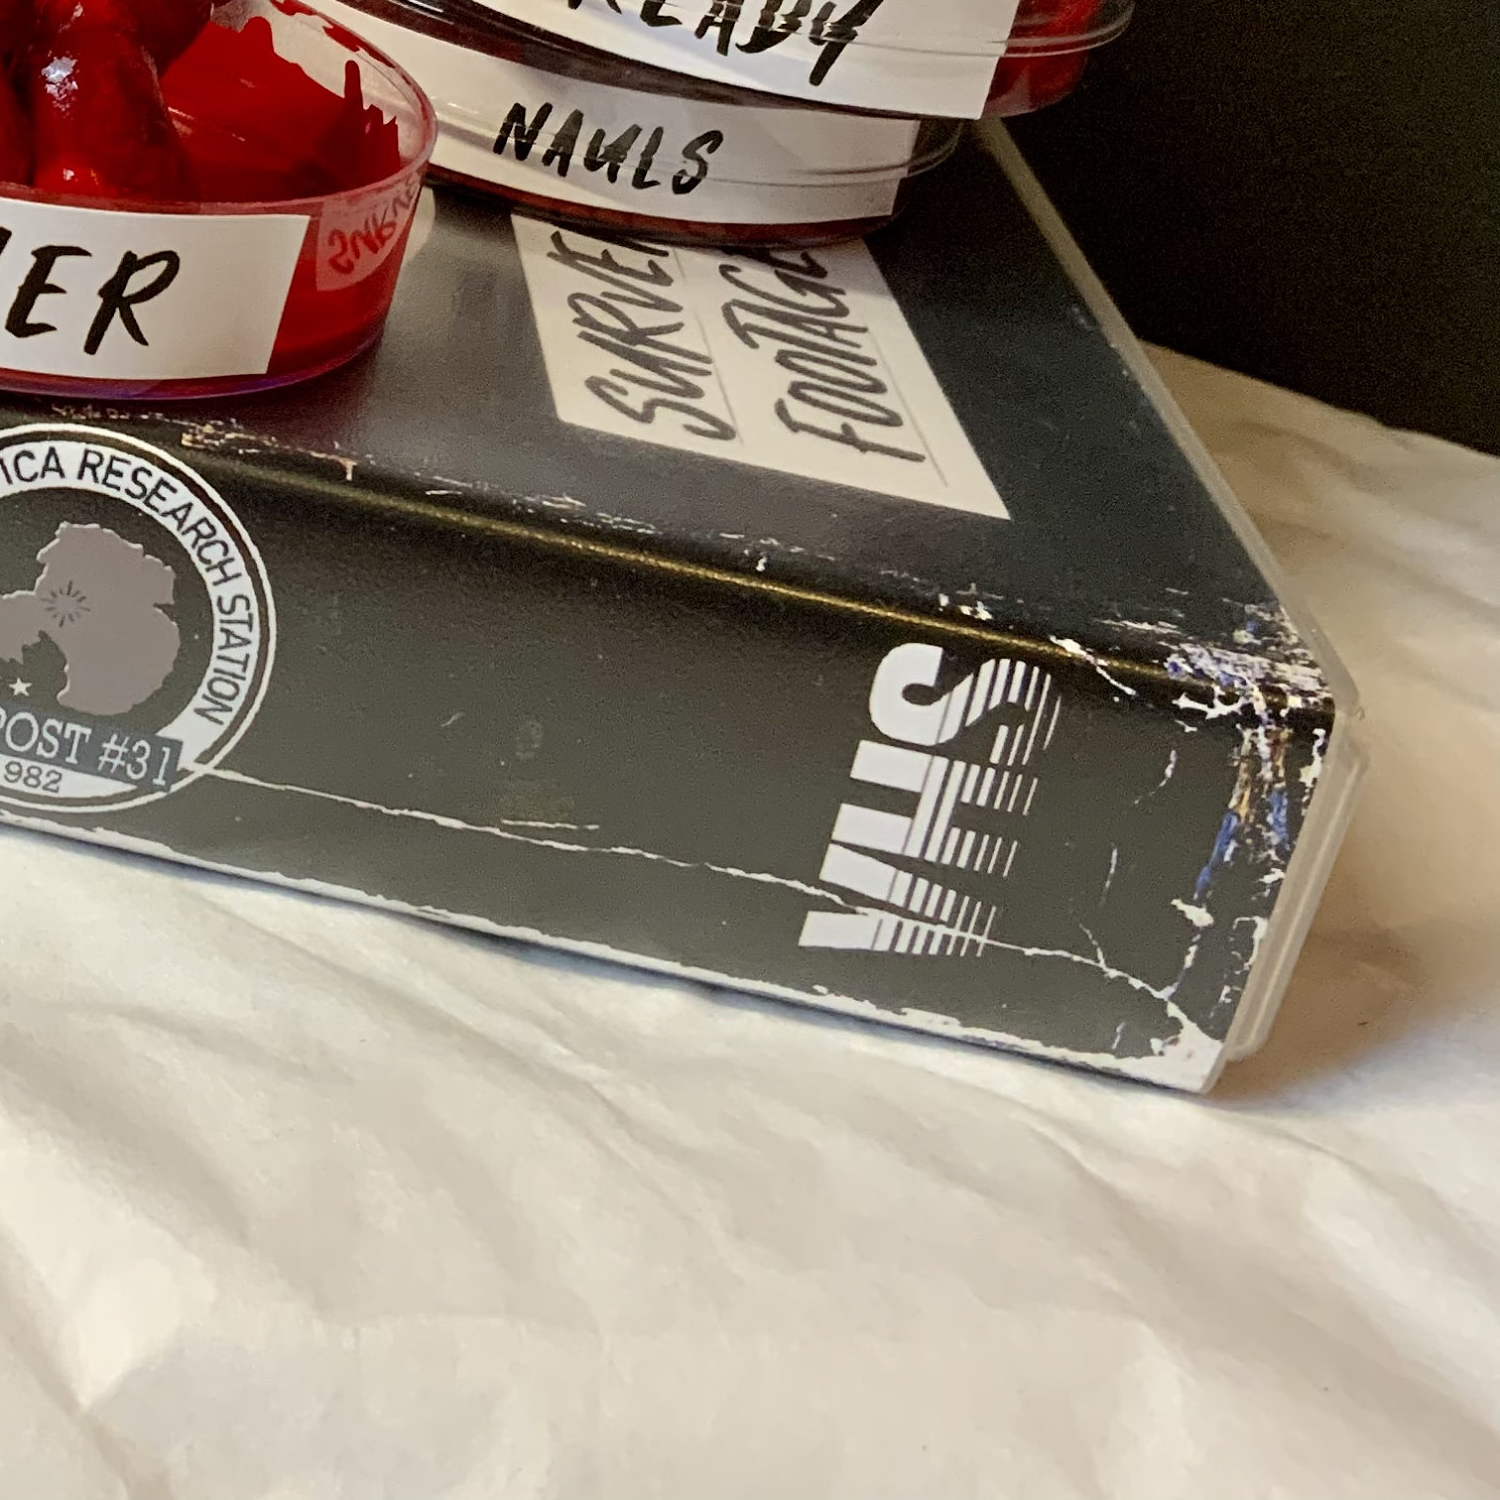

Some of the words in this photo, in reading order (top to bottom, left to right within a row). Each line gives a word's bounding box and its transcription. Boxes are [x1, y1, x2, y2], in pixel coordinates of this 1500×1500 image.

[491, 100, 725, 196] NAULS
[76, 448, 243, 588] RESEARCH
[193, 593, 256, 727] STATION
[98, 734, 172, 788] #31
[799, 642, 1061, 956] VHS
